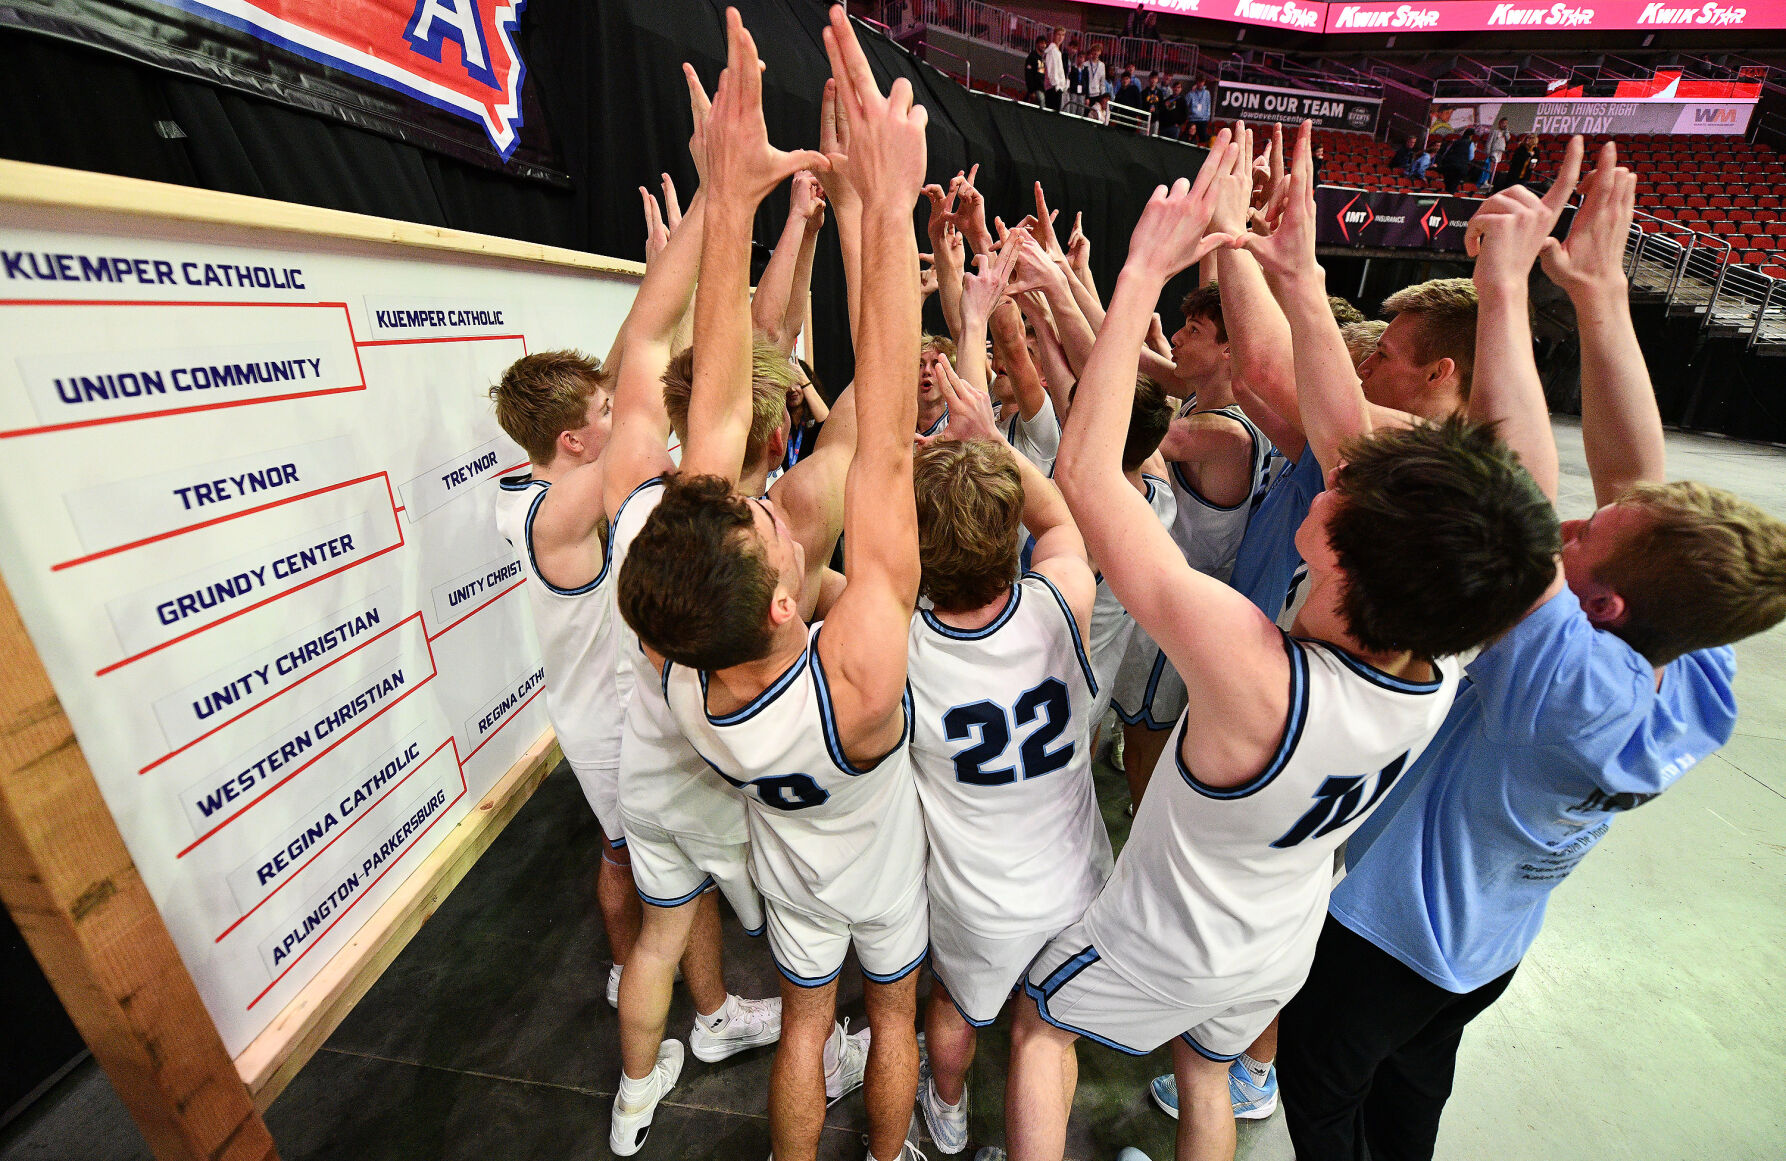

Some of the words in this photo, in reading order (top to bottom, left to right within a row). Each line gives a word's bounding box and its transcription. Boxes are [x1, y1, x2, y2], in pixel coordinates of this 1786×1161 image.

[1335, 6, 1391, 28] KWIK
[1393, 5, 1440, 29] STAR
[1487, 4, 1545, 25] KWIK
[1546, 3, 1595, 27] STAR
[1636, 3, 1695, 24] KWIK
[1696, 2, 1747, 26] STAR
[1221, 91, 1260, 108] JOIN
[1264, 96, 1299, 114] OUR
[1302, 99, 1345, 118] TEAM
[1536, 103, 1569, 116] DOING
[1571, 103, 1607, 116] THINGS
[1607, 103, 1640, 116] RIGHT
[1694, 108, 1737, 123] WM
[1532, 116, 1580, 134] EVERY
[1582, 116, 1613, 134] DAY
[1345, 211, 1367, 223] IMT
[1375, 215, 1405, 224] INSURANCE
[1, 251, 177, 284] KUEMPER
[182, 263, 305, 289] CATHOLIC
[376, 311, 446, 327] KUEMPER
[448, 311, 504, 326] CATHOLIC
[55, 371, 166, 403] UNION
[171, 358, 320, 391] COMMUNITY
[174, 464, 299, 509] TREYNOR
[442, 452, 498, 490] TREYNOR
[157, 566, 264, 625] GRUNDY
[273, 534, 355, 579] CENTER
[449, 578, 483, 606] UNITY
[487, 560, 521, 587] CHRIST
[193, 665, 268, 719] UNITY
[276, 608, 380, 675] CHRISTIAN
[478, 693, 517, 734] REGINA
[941, 676, 1075, 786] 22
[197, 731, 312, 817] WESTERN
[315, 669, 404, 739] CHRISTIAN
[257, 813, 338, 885] REGINA
[340, 742, 419, 816] CATHOLIC
[274, 789, 445, 965] APLINGTON-PARKERSBURG
